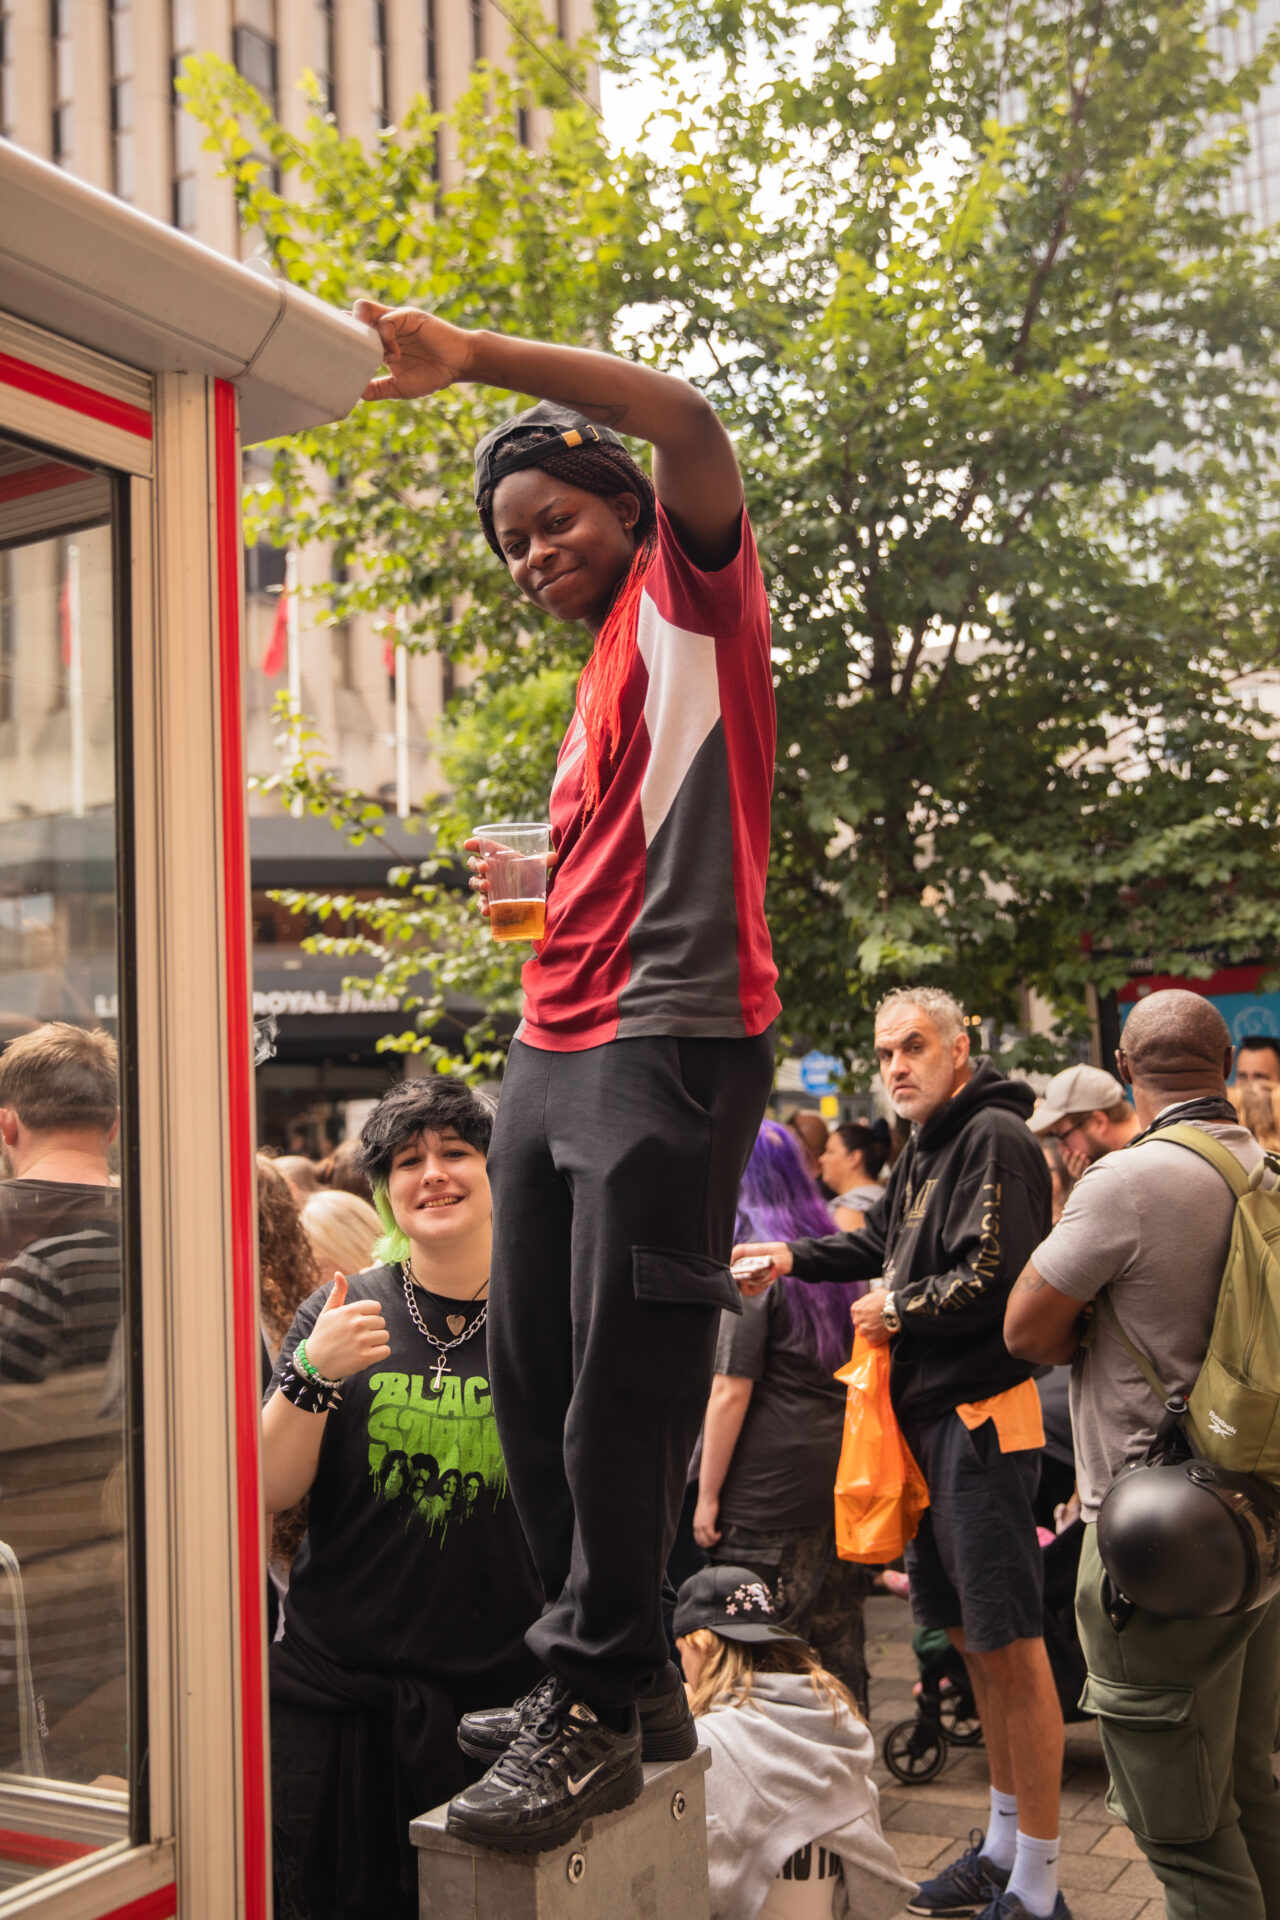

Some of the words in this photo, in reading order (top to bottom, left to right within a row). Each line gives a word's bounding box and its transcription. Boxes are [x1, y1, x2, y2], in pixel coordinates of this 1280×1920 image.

[253, 990, 335, 1014] ROYAL
[369, 1372, 493, 1418] BLAC
[368, 1405, 507, 1478] SABBA
